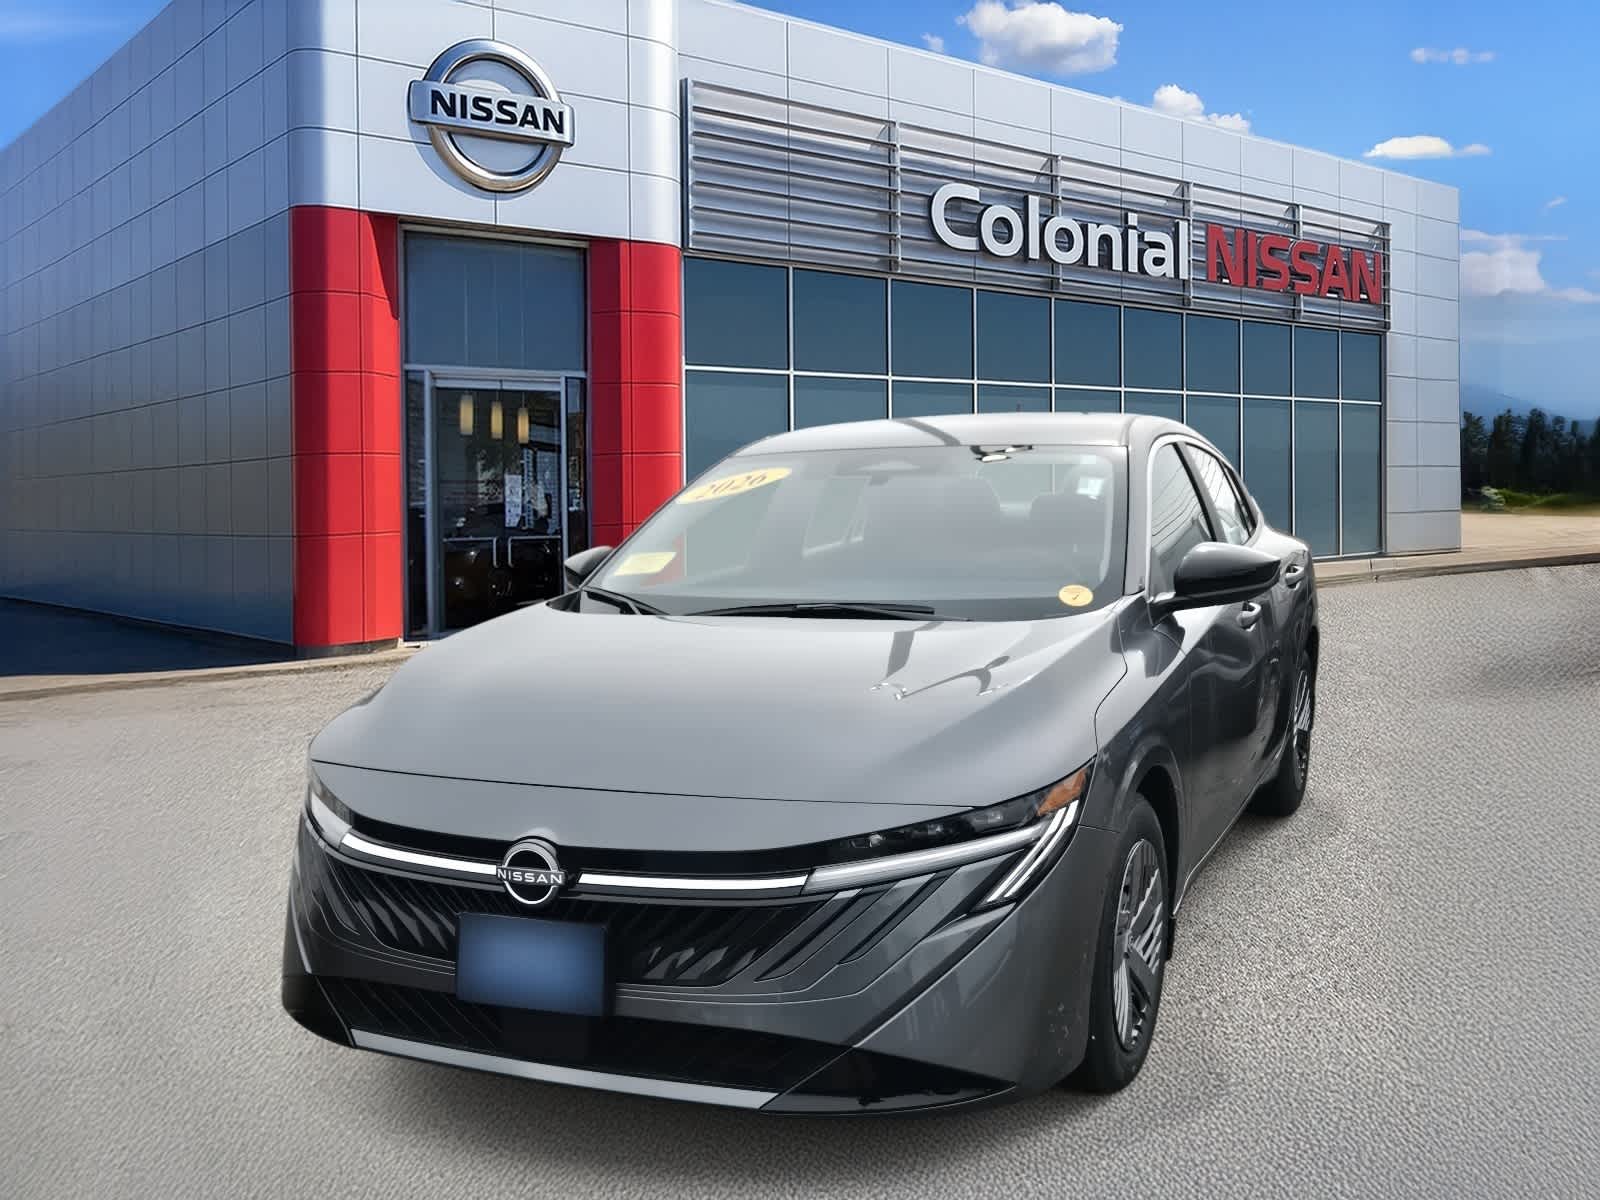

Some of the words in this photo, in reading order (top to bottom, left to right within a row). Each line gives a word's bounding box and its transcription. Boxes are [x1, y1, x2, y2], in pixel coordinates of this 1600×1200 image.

[430, 89, 564, 134] NISSAN
[930, 182, 1188, 280] Colonial
[1206, 223, 1383, 305] NISSAN
[497, 869, 563, 884] NISSAN
